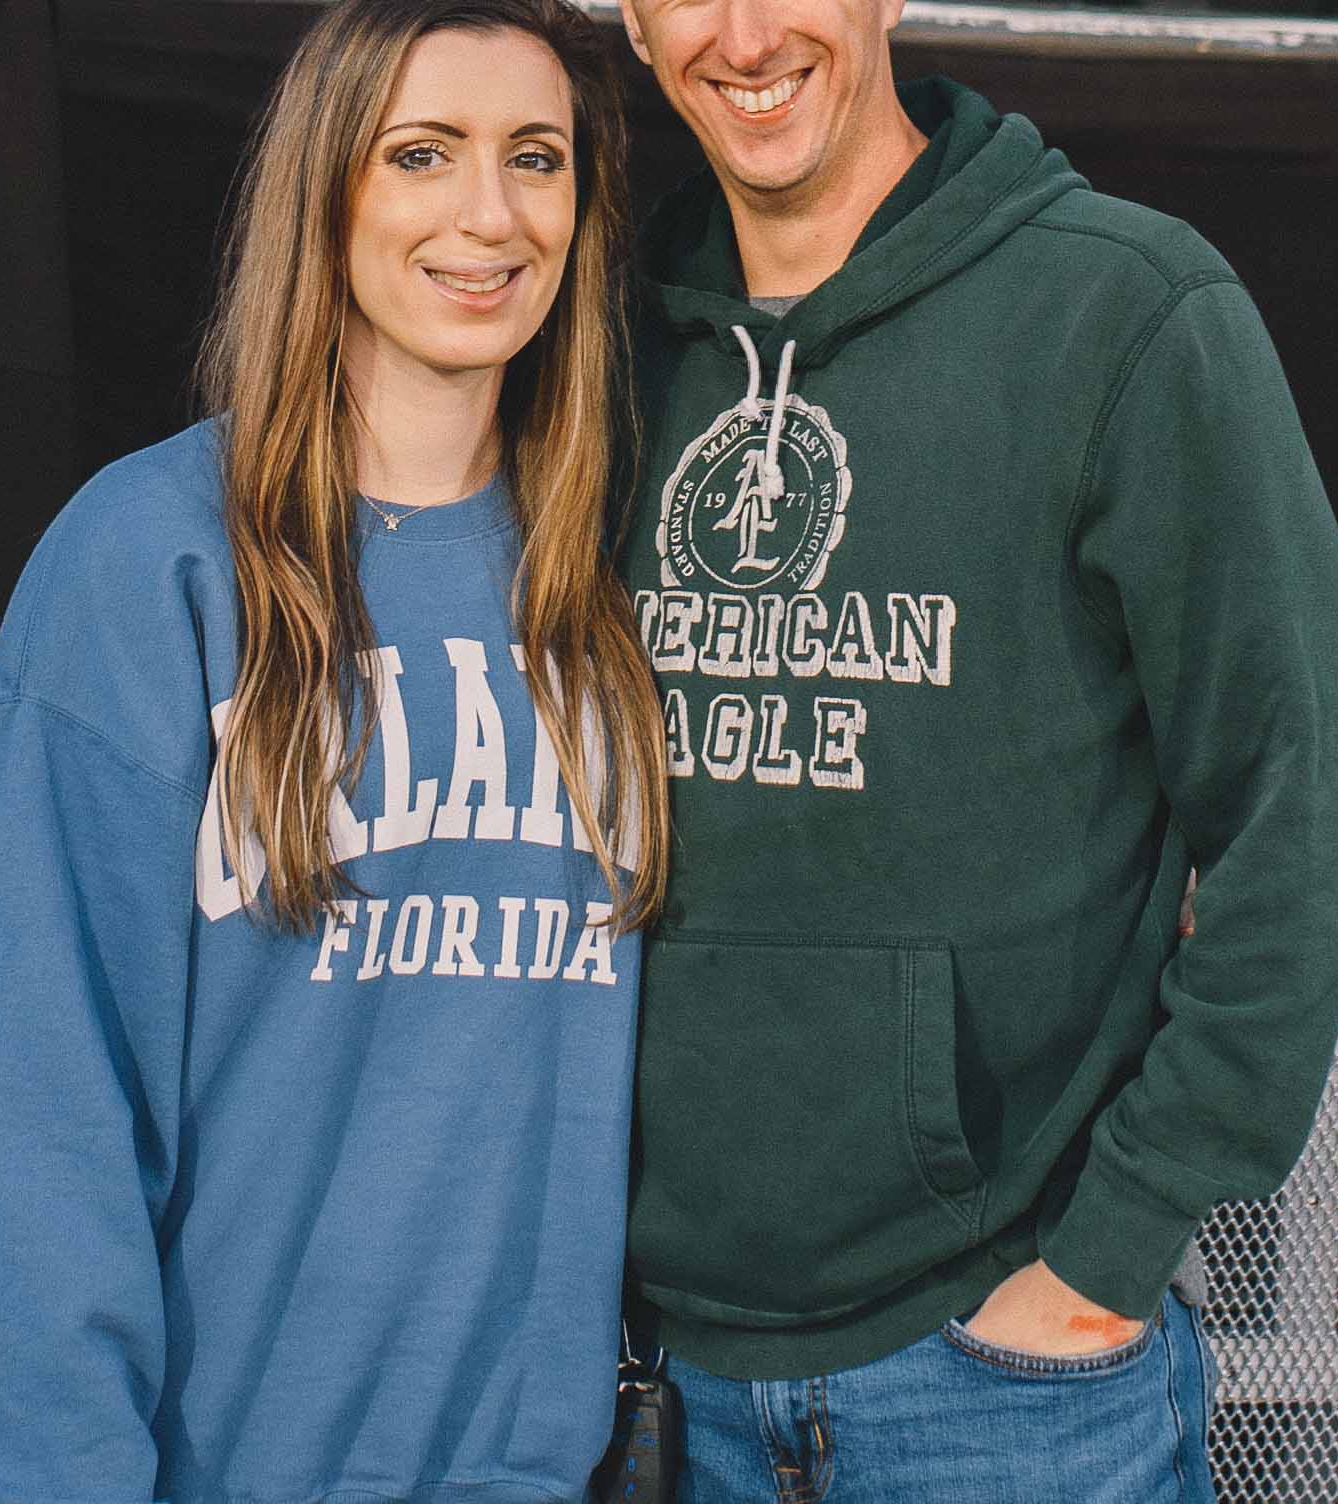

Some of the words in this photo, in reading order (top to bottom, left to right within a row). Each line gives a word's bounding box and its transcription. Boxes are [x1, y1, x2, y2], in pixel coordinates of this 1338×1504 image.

[700, 418, 751, 464] MADE
[787, 420, 828, 463] LAST
[670, 479, 696, 577] STANDARD
[703, 492, 726, 508] 19
[785, 492, 807, 508] 77
[787, 481, 832, 583] TRADITION
[635, 590, 957, 686] ERICAN
[665, 689, 867, 790] AGLE
[310, 894, 617, 985] FLORIDA
